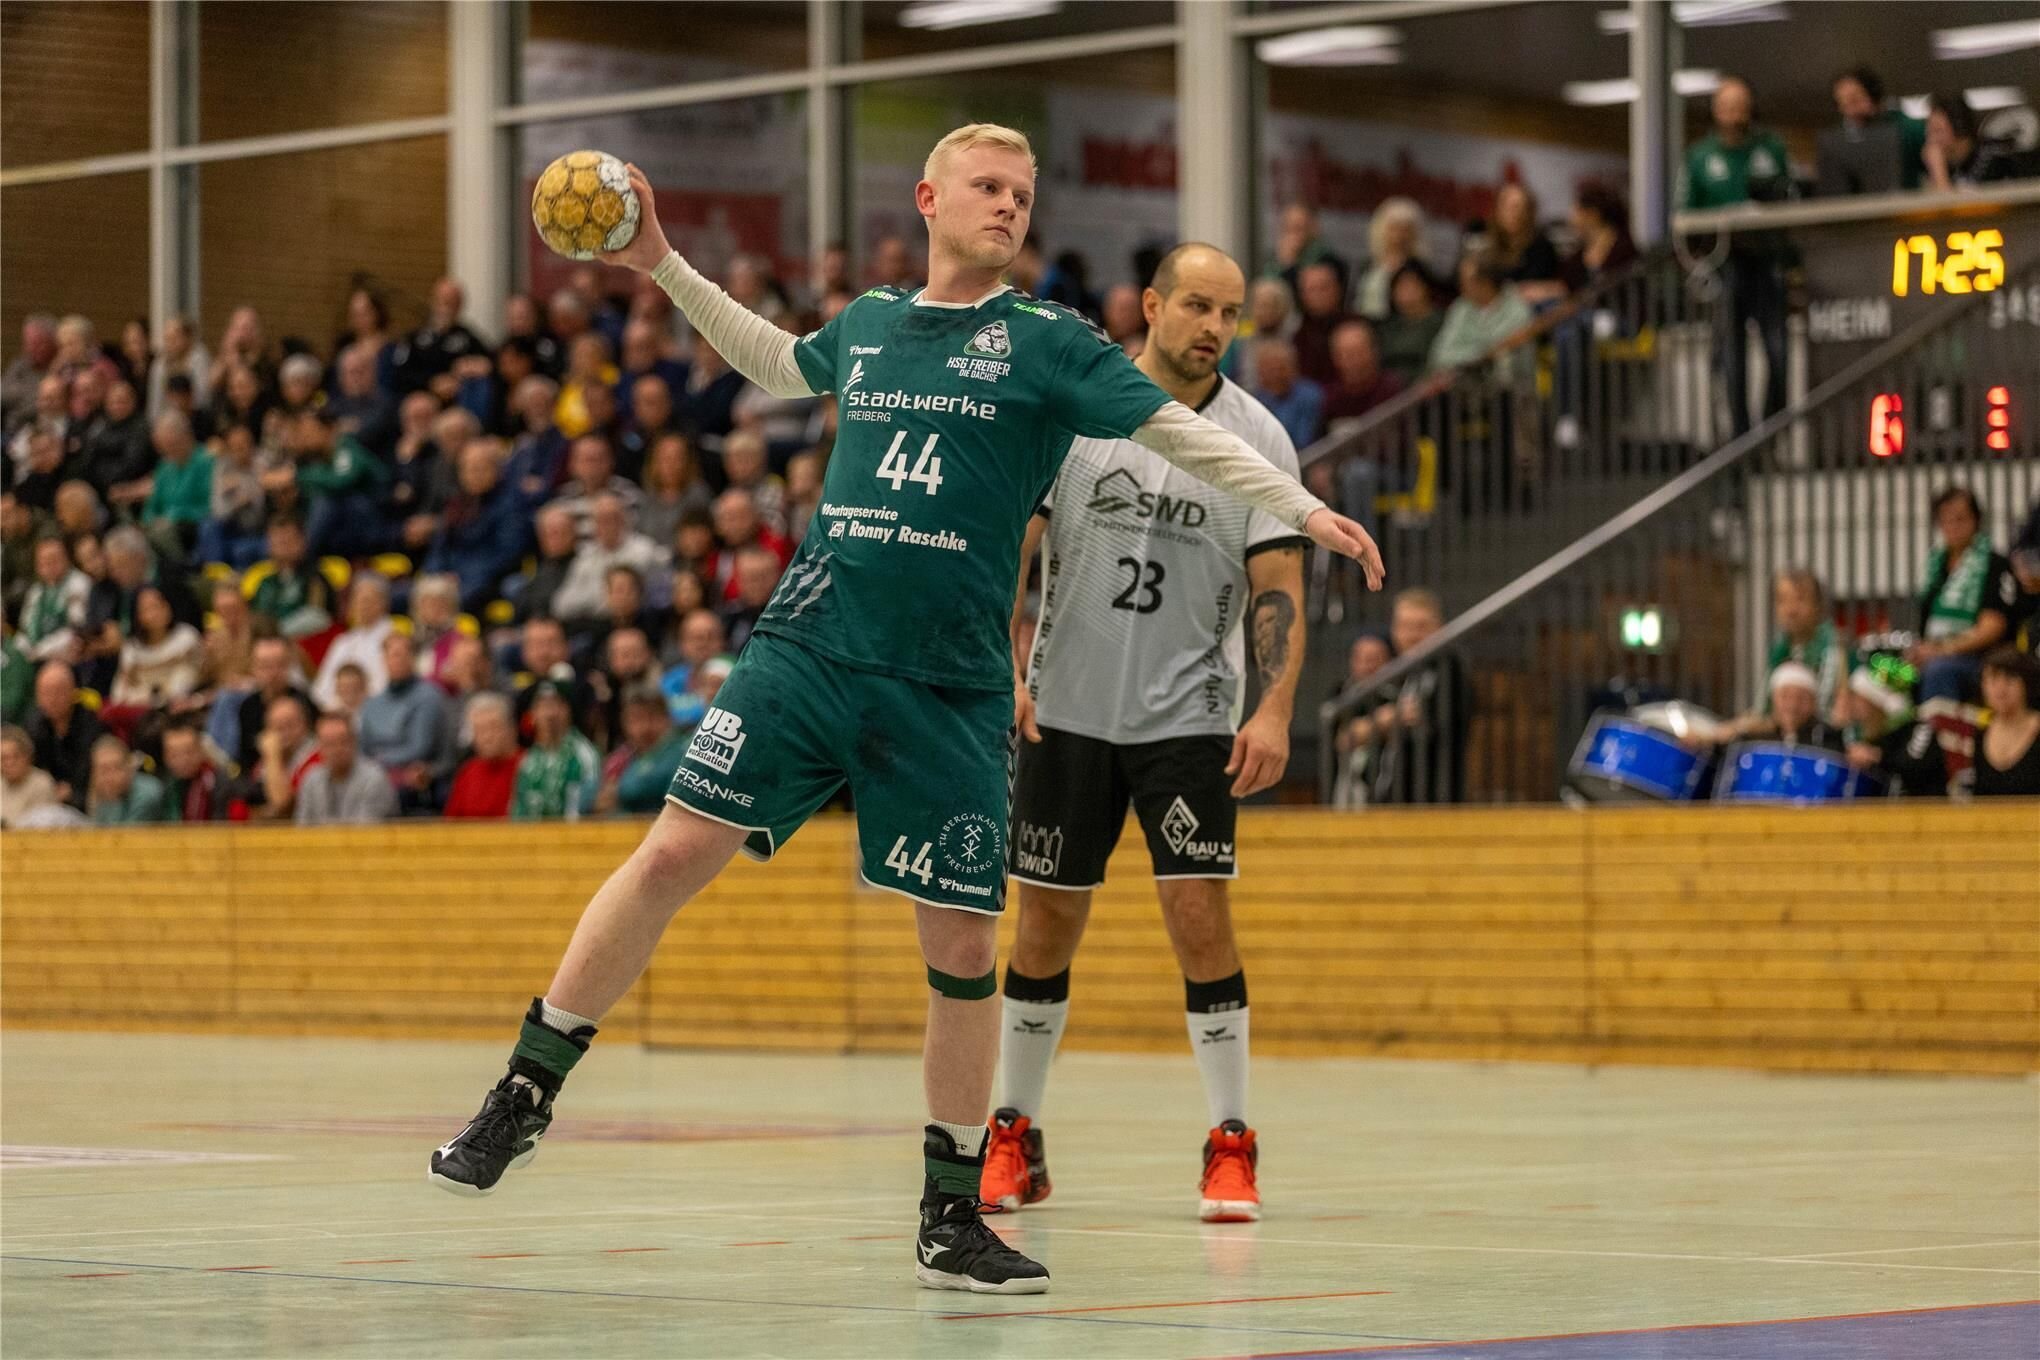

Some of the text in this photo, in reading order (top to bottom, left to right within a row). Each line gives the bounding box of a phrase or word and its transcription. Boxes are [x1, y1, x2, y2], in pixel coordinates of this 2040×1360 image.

[946, 357, 968, 369] HSG
[959, 369, 971, 378] DIE
[847, 411, 891, 422] FREIBERG
[876, 430, 943, 496] 44
[822, 503, 899, 521] Montageservice
[1137, 492, 1206, 528] SWD
[849, 520, 895, 544] Ronny
[897, 525, 967, 551] Raschke
[1112, 557, 1165, 614] 23
[1205, 673, 1222, 714] NHV
[673, 766, 755, 807] FRANKE
[884, 835, 933, 886] 44
[1186, 841, 1219, 856] BAU
[944, 853, 993, 875] FREIBERG
[951, 879, 992, 896] hummel
